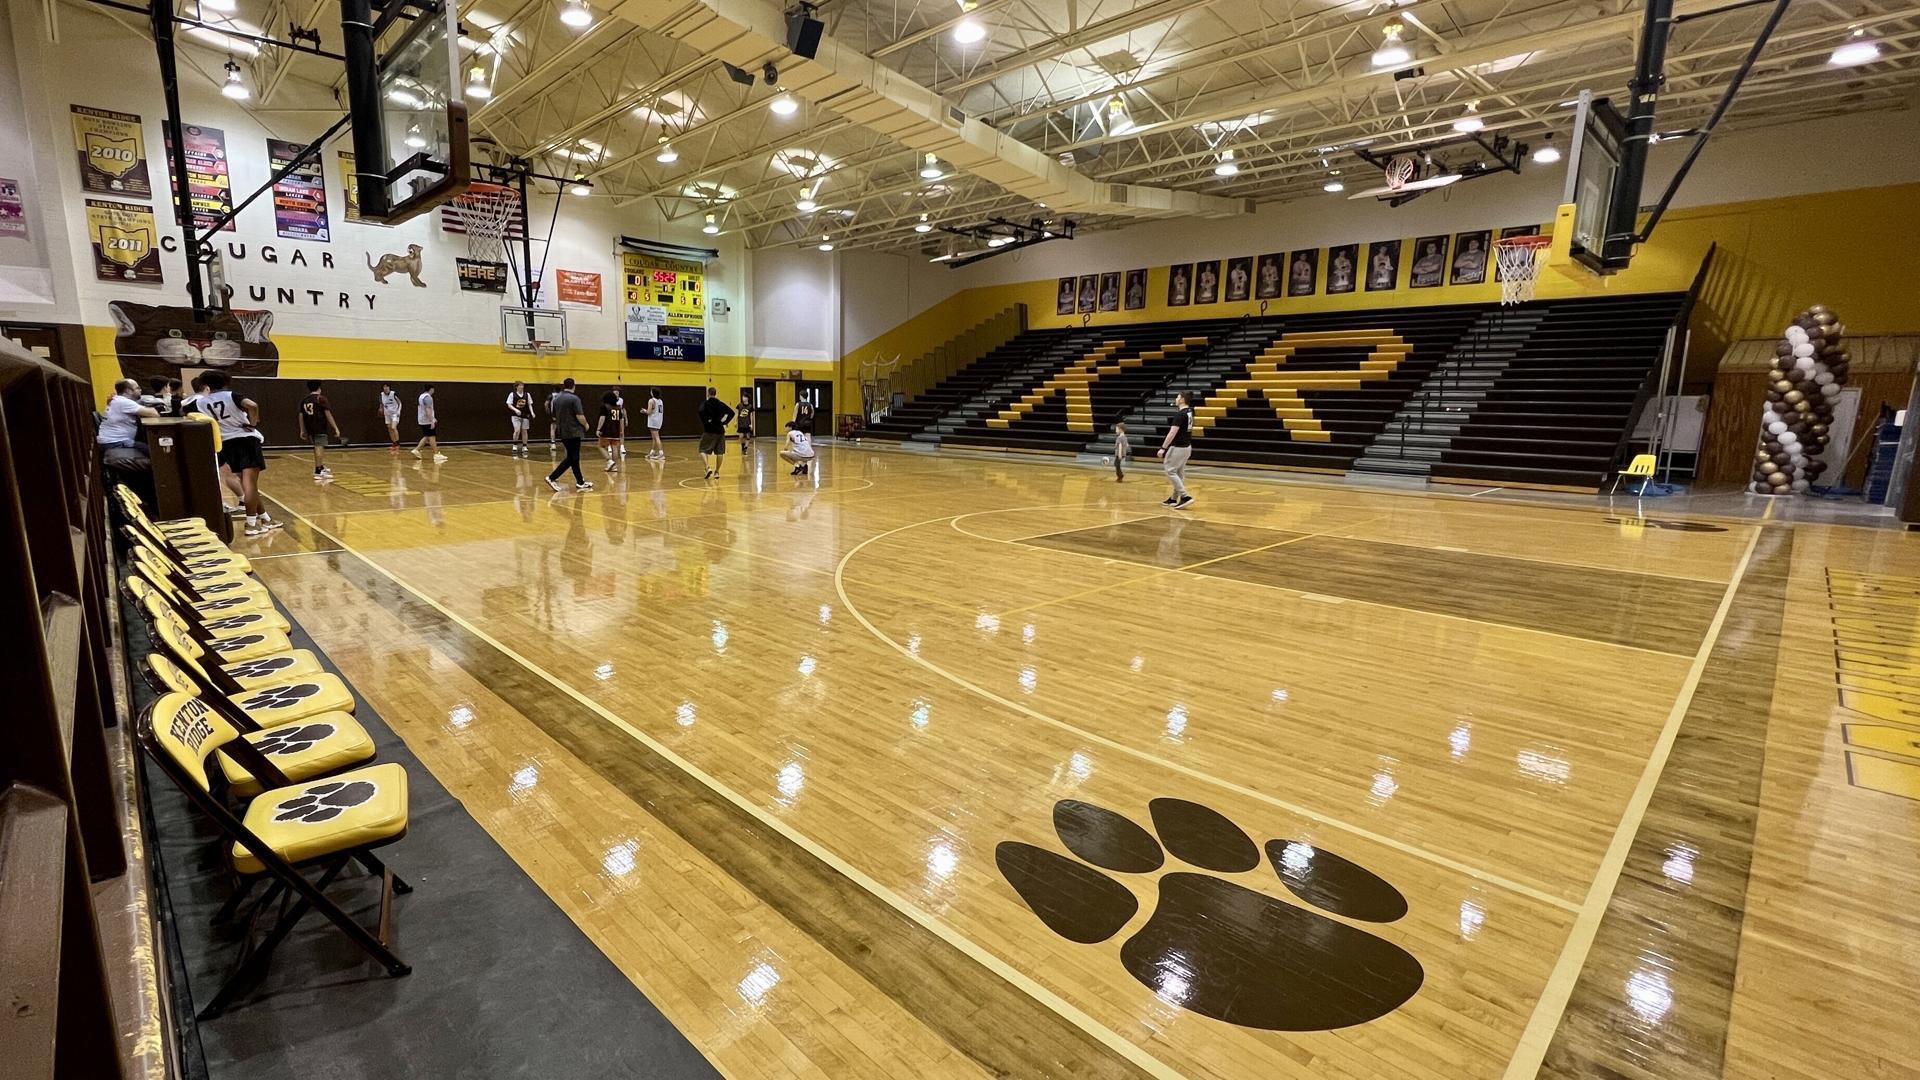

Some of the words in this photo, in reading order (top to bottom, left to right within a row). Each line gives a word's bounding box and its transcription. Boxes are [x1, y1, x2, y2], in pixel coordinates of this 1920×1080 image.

[91, 144, 134, 163] 2010
[91, 200, 123, 210] KENTON
[108, 237, 143, 252] 2011
[160, 235, 334, 269] COUGAR
[459, 267, 496, 280] HERE
[663, 345, 683, 357] Park
[206, 400, 231, 422] 12
[610, 409, 620, 421] 31
[169, 698, 210, 747] KENTON
[186, 716, 215, 757] RIDGE
